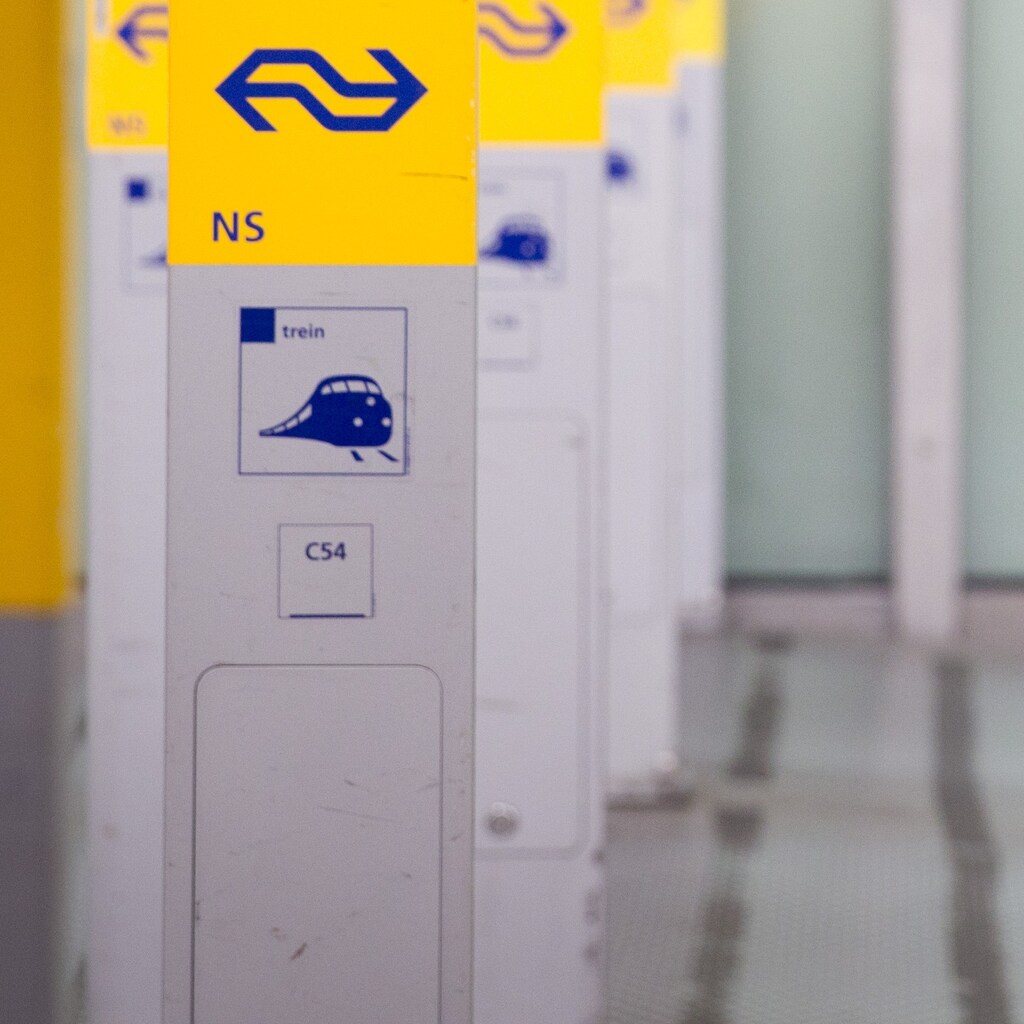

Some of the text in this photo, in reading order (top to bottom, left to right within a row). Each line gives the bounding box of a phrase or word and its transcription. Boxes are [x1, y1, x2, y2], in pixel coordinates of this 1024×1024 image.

[212, 211, 265, 242] NS
[282, 323, 325, 338] trein
[305, 541, 347, 561] C54
